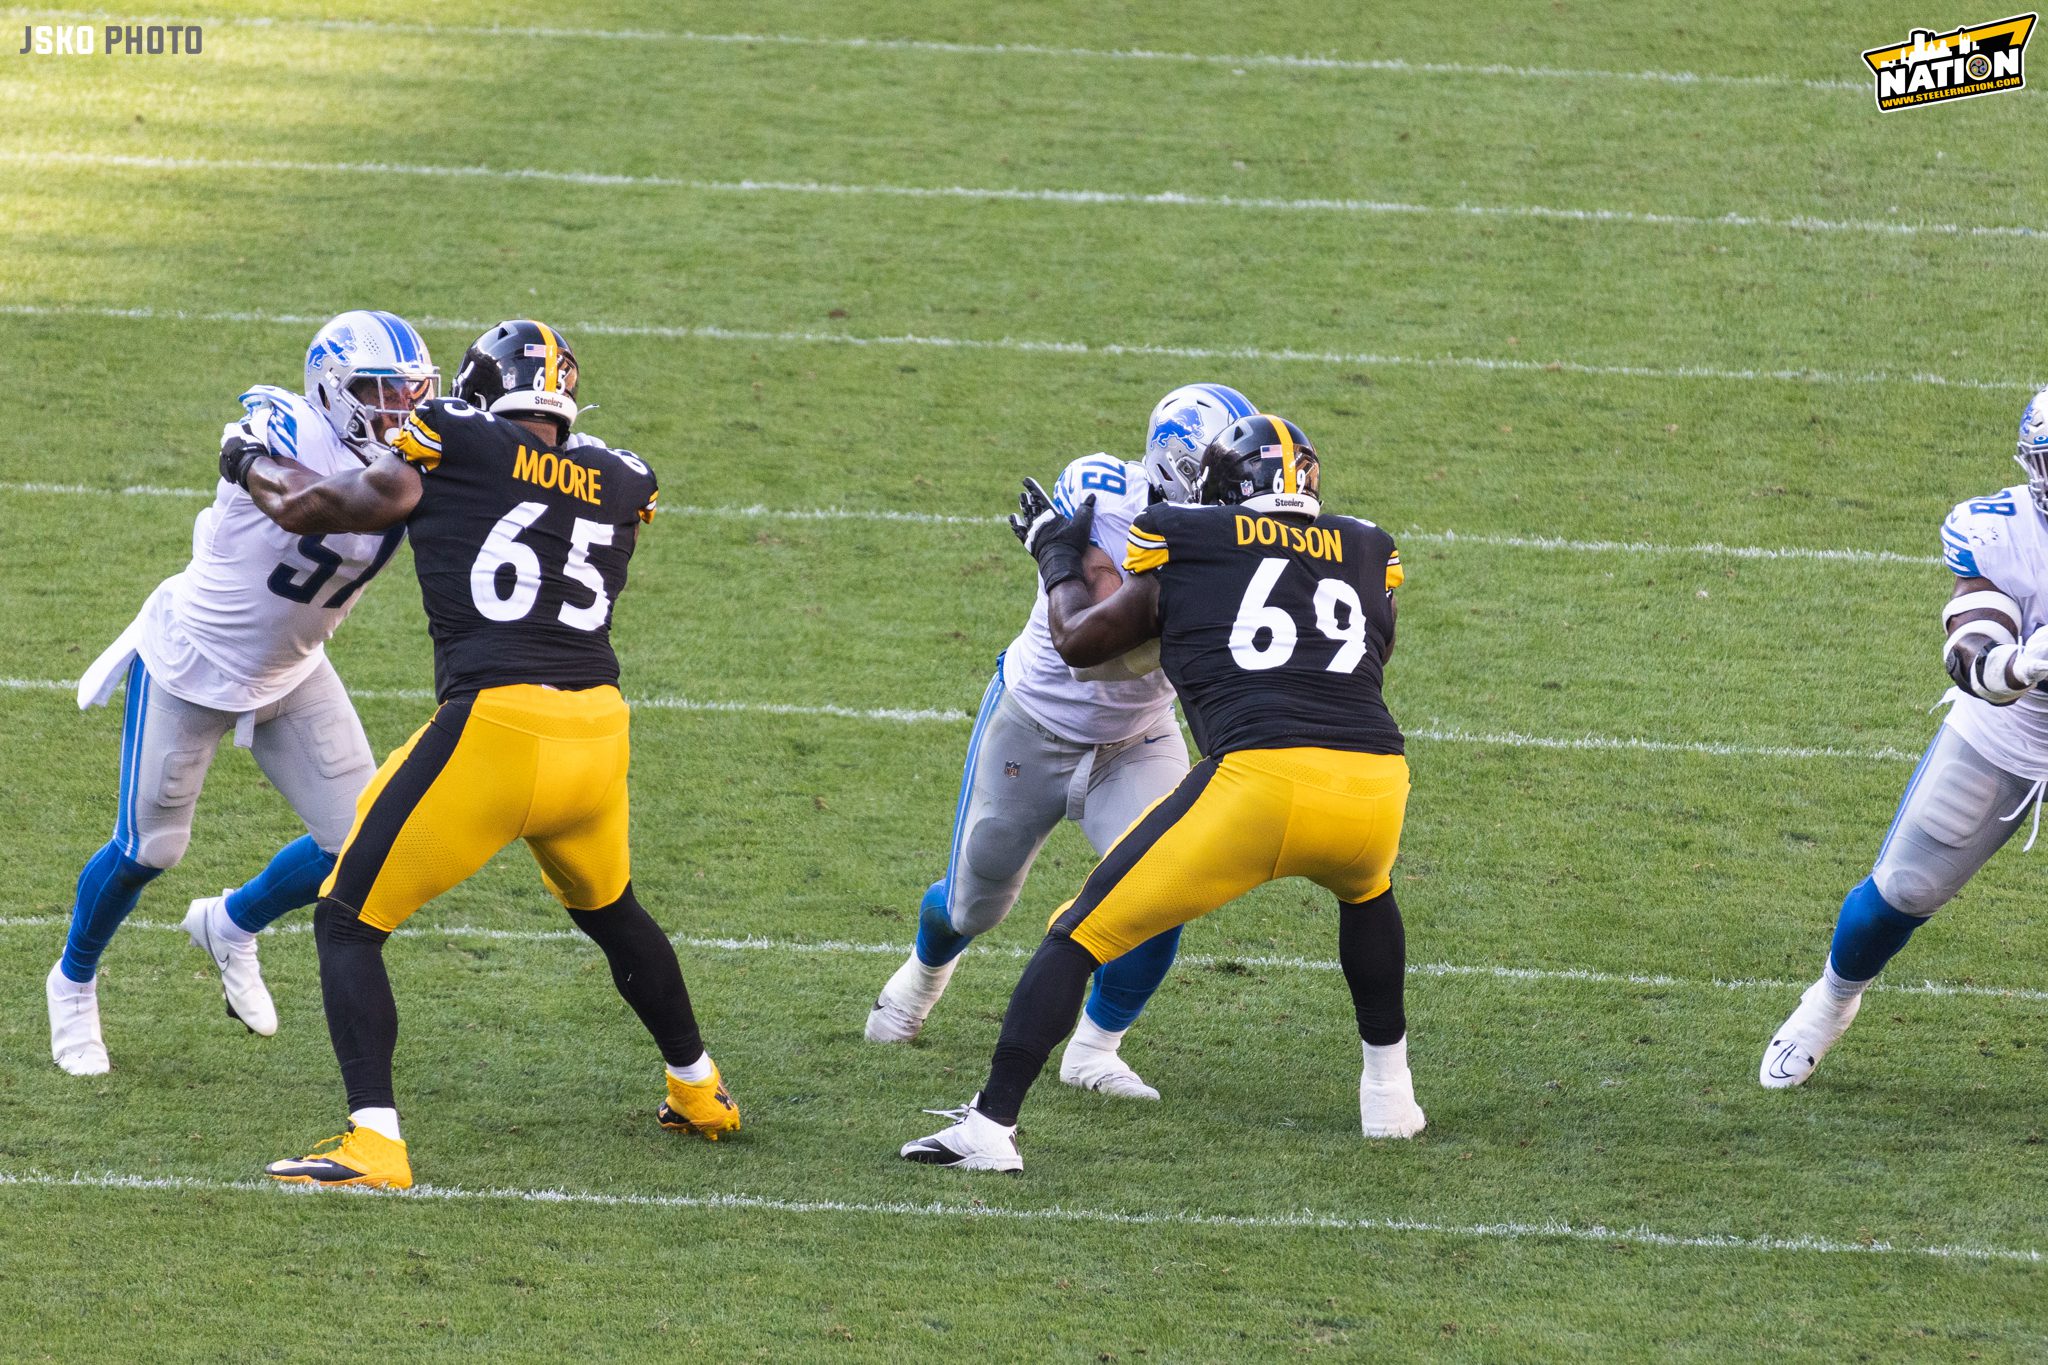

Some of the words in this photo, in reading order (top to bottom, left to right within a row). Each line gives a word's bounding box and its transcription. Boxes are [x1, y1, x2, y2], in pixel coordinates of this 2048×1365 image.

[533, 367, 566, 395] 65
[534, 395, 563, 409] Steelers
[512, 444, 602, 506] MOORE
[1081, 461, 1127, 496] 79
[1272, 468, 1306, 494] 69
[1275, 498, 1304, 508] Steelers
[1235, 515, 1343, 563] DOTSON
[470, 501, 615, 632] 65
[1228, 557, 1368, 674] 69
